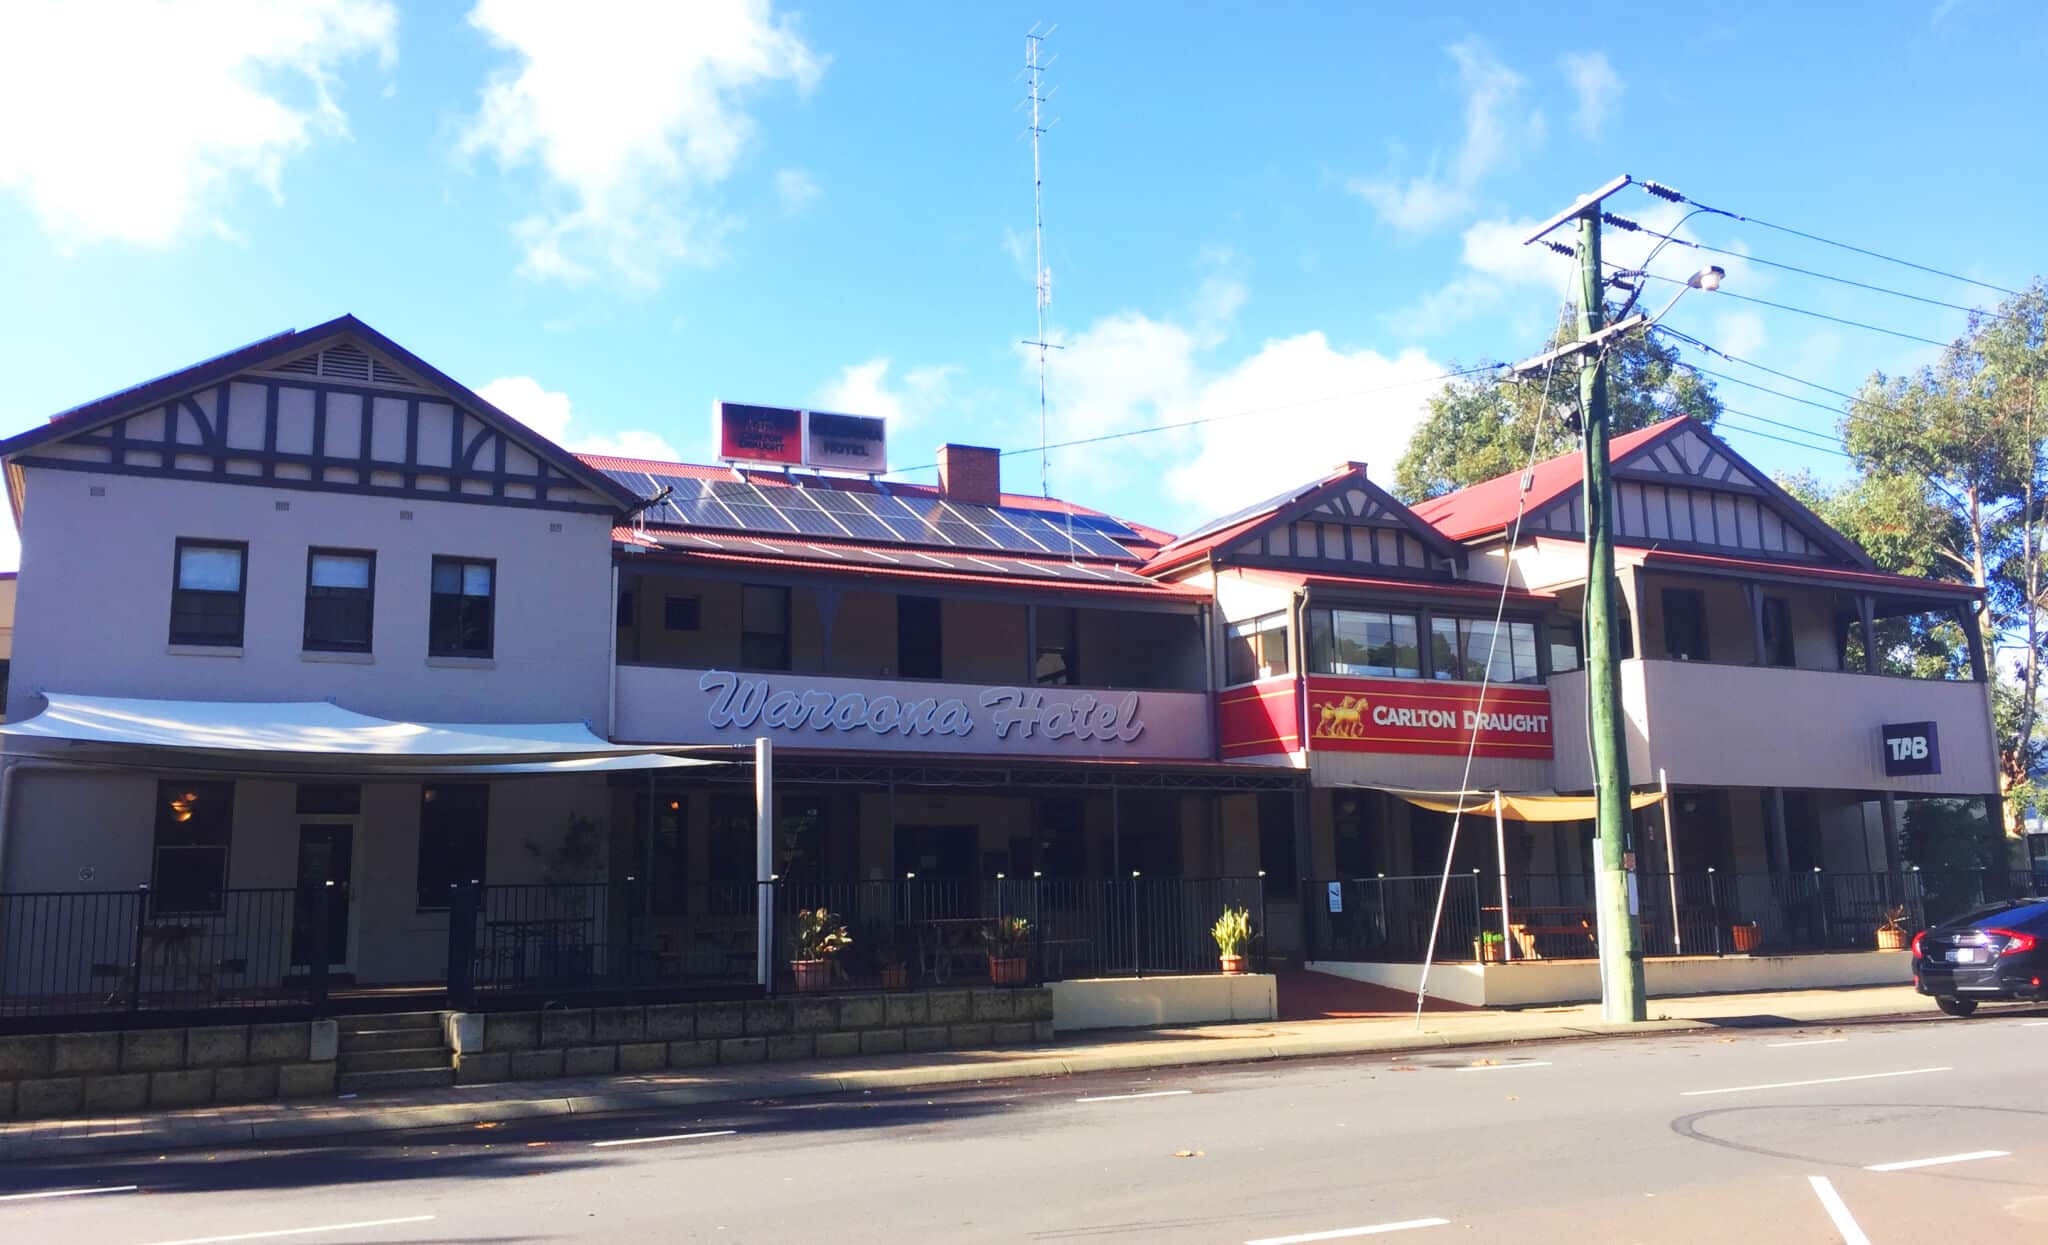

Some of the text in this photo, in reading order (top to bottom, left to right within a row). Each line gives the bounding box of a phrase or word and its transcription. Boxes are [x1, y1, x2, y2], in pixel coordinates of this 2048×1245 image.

[823, 442, 869, 457] HOTEL
[699, 668, 1145, 742] Waroona Hotel
[1372, 705, 1549, 733] CARLTON DRAUGHT
[1886, 736, 1929, 761] TAB
